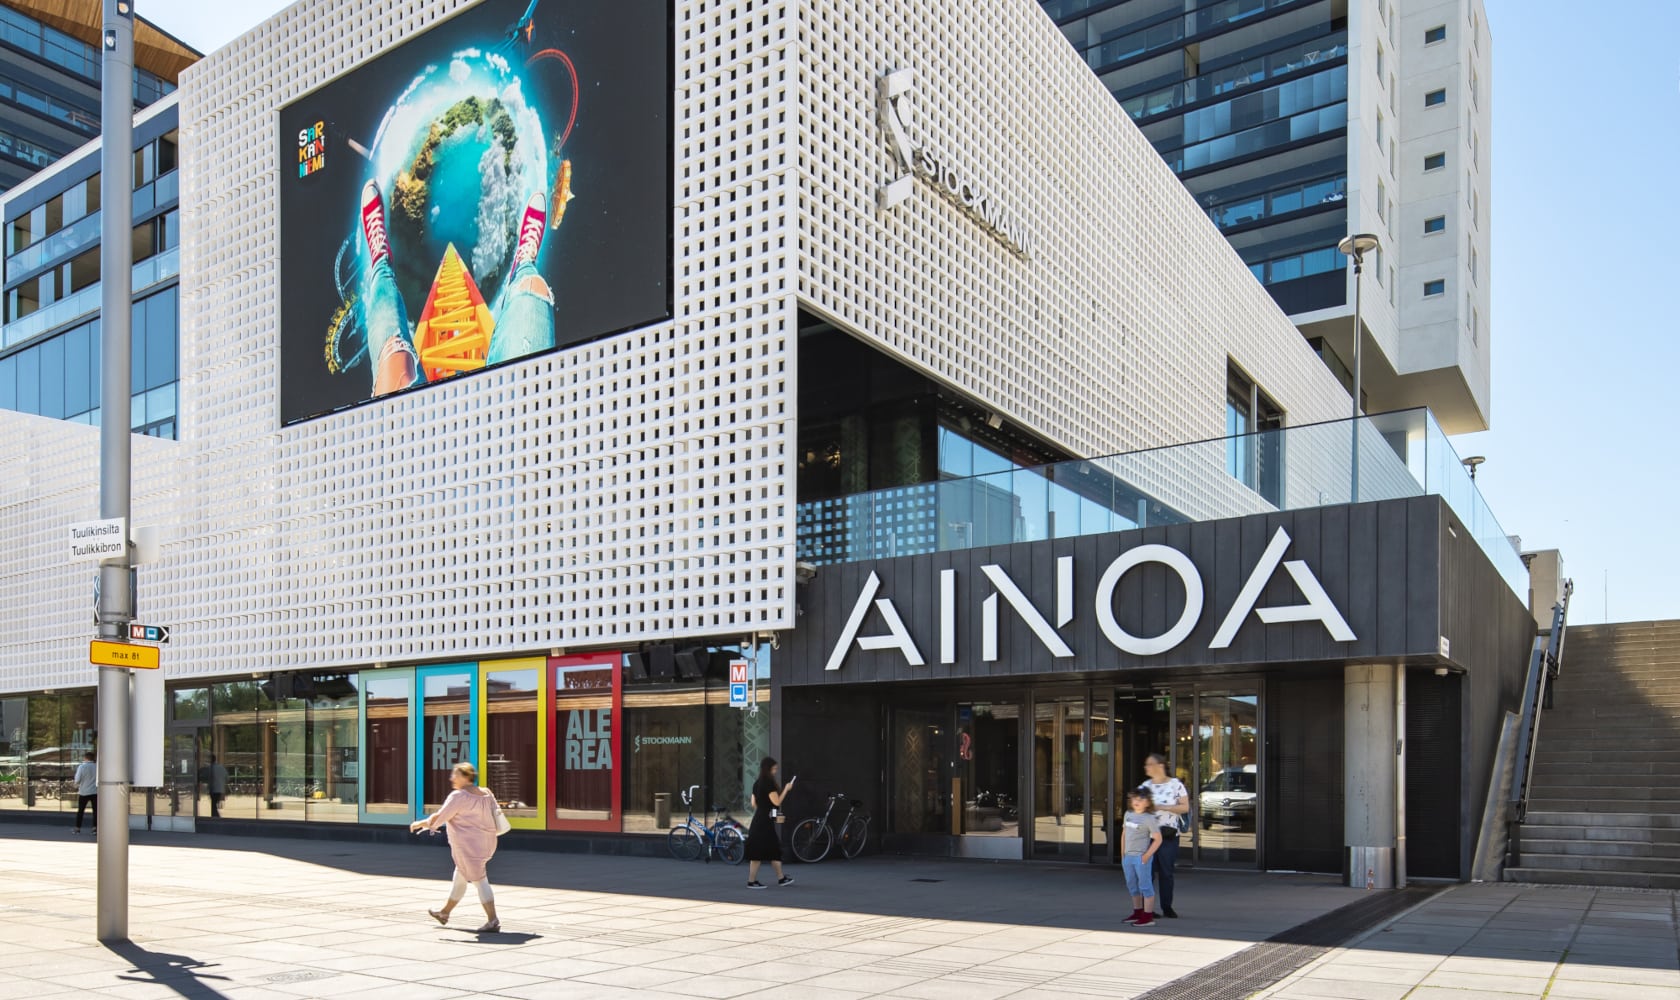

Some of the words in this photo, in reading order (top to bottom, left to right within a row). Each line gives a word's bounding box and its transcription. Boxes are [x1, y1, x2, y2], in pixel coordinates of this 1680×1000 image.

[921, 146, 1035, 258] STOCKMANN
[72, 524, 120, 539] Tuulikinsilta
[72, 542, 122, 556] Tuulikkibron
[824, 525, 1358, 671] AINOA
[133, 628, 145, 638] M
[112, 651, 129, 660] max
[733, 666, 746, 682] M
[432, 714, 470, 742] ALE
[566, 708, 612, 739] ALE
[641, 735, 692, 745] STOCKMANN
[565, 739, 613, 770] REA
